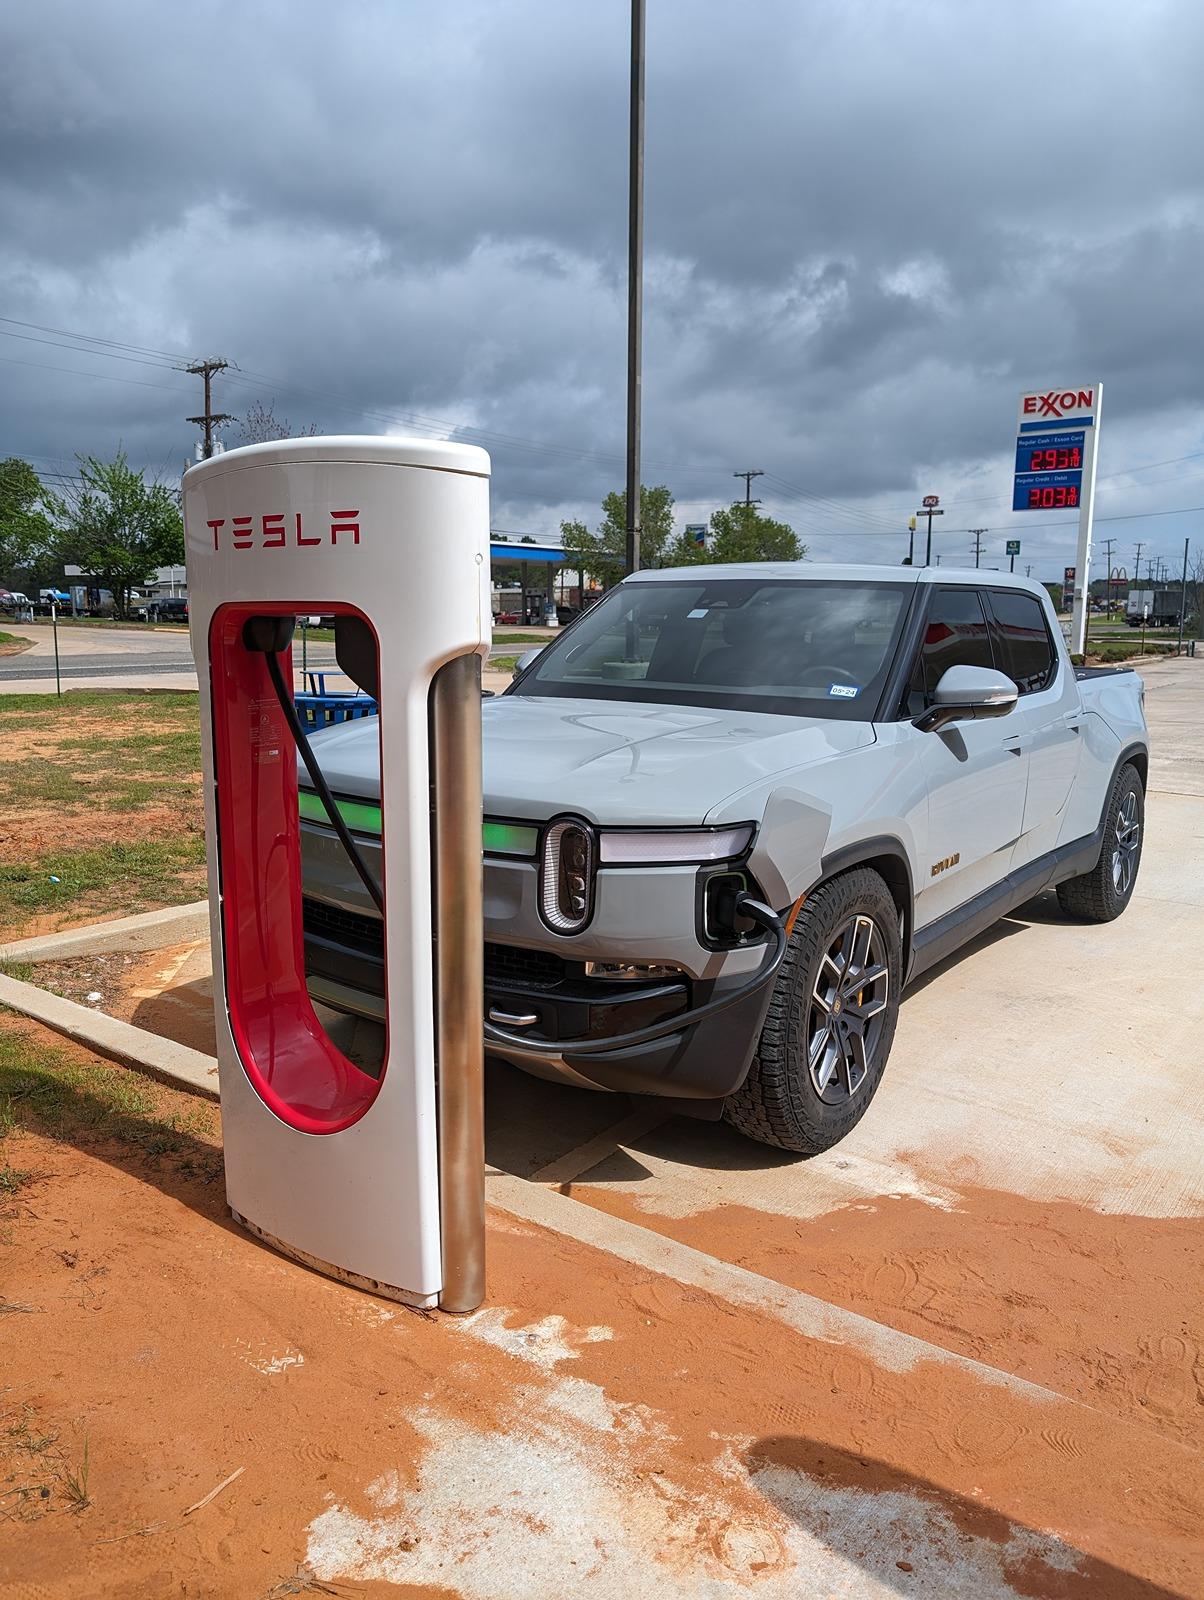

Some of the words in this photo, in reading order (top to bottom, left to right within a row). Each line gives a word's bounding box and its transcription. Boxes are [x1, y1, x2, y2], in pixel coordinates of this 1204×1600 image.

[1023, 390, 1093, 417] EXXON
[1031, 449, 1069, 471] 2.93
[924, 497, 937, 505] DQ
[1030, 487, 1066, 507] 3.03
[206, 510, 360, 551] TESLA
[832, 687, 856, 696] 05-24
